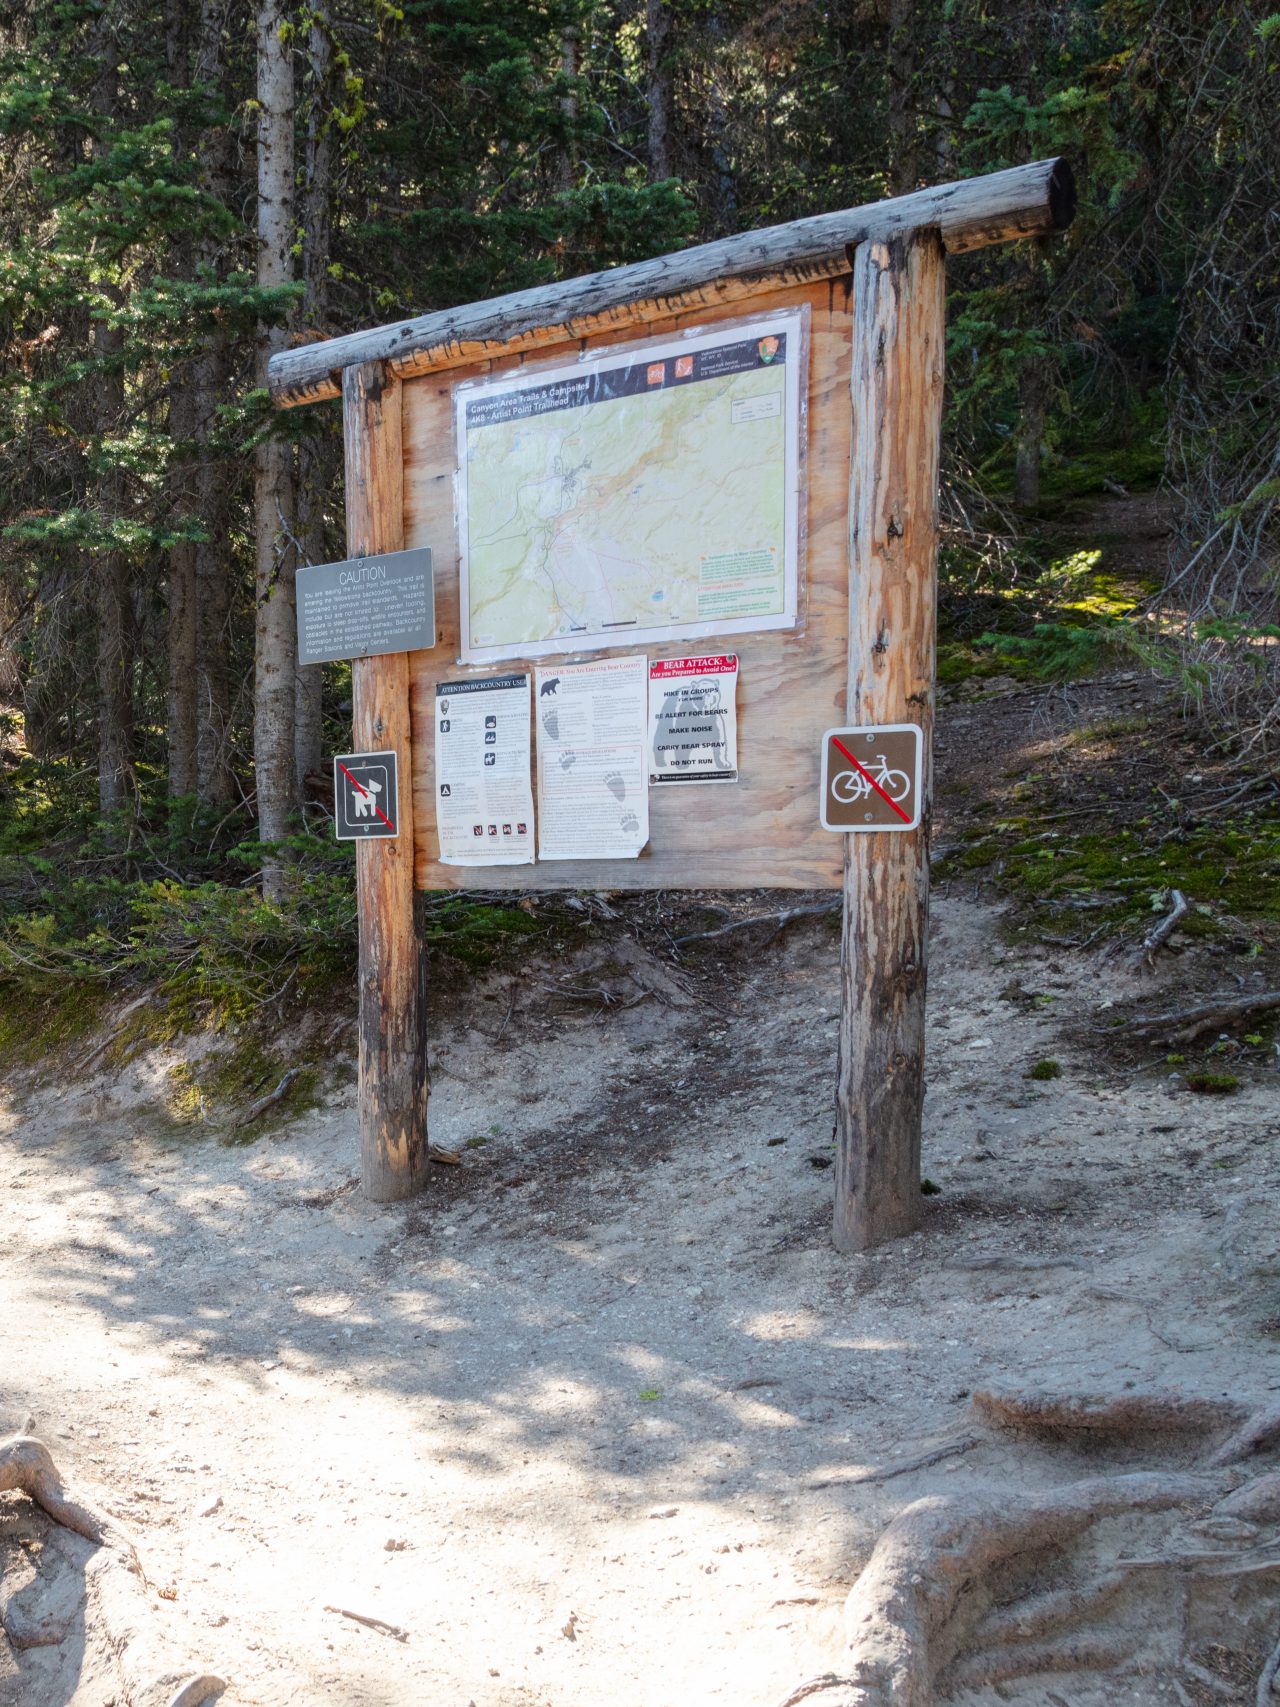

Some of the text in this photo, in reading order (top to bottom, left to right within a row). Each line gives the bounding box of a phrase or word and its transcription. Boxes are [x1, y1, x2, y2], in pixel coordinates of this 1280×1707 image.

[471, 383, 590, 414] Canyon Area Trails & Campsites
[471, 414, 485, 424] 4K8
[491, 409, 511, 420] Artist
[513, 404, 532, 415] Point
[534, 396, 568, 411] Trailhead
[339, 565, 386, 586] CAUTION
[367, 581, 379, 589] Point
[380, 578, 401, 587] Overlook
[333, 594, 360, 602] Yellowstone
[403, 591, 424, 599] Hazards
[664, 657, 722, 670] BEAR ATTACK:
[672, 668, 695, 677] Prepared
[442, 684, 470, 694] ATTENTION
[471, 680, 511, 691] BACKCOUNTRY
[691, 687, 719, 695] GROUPS
